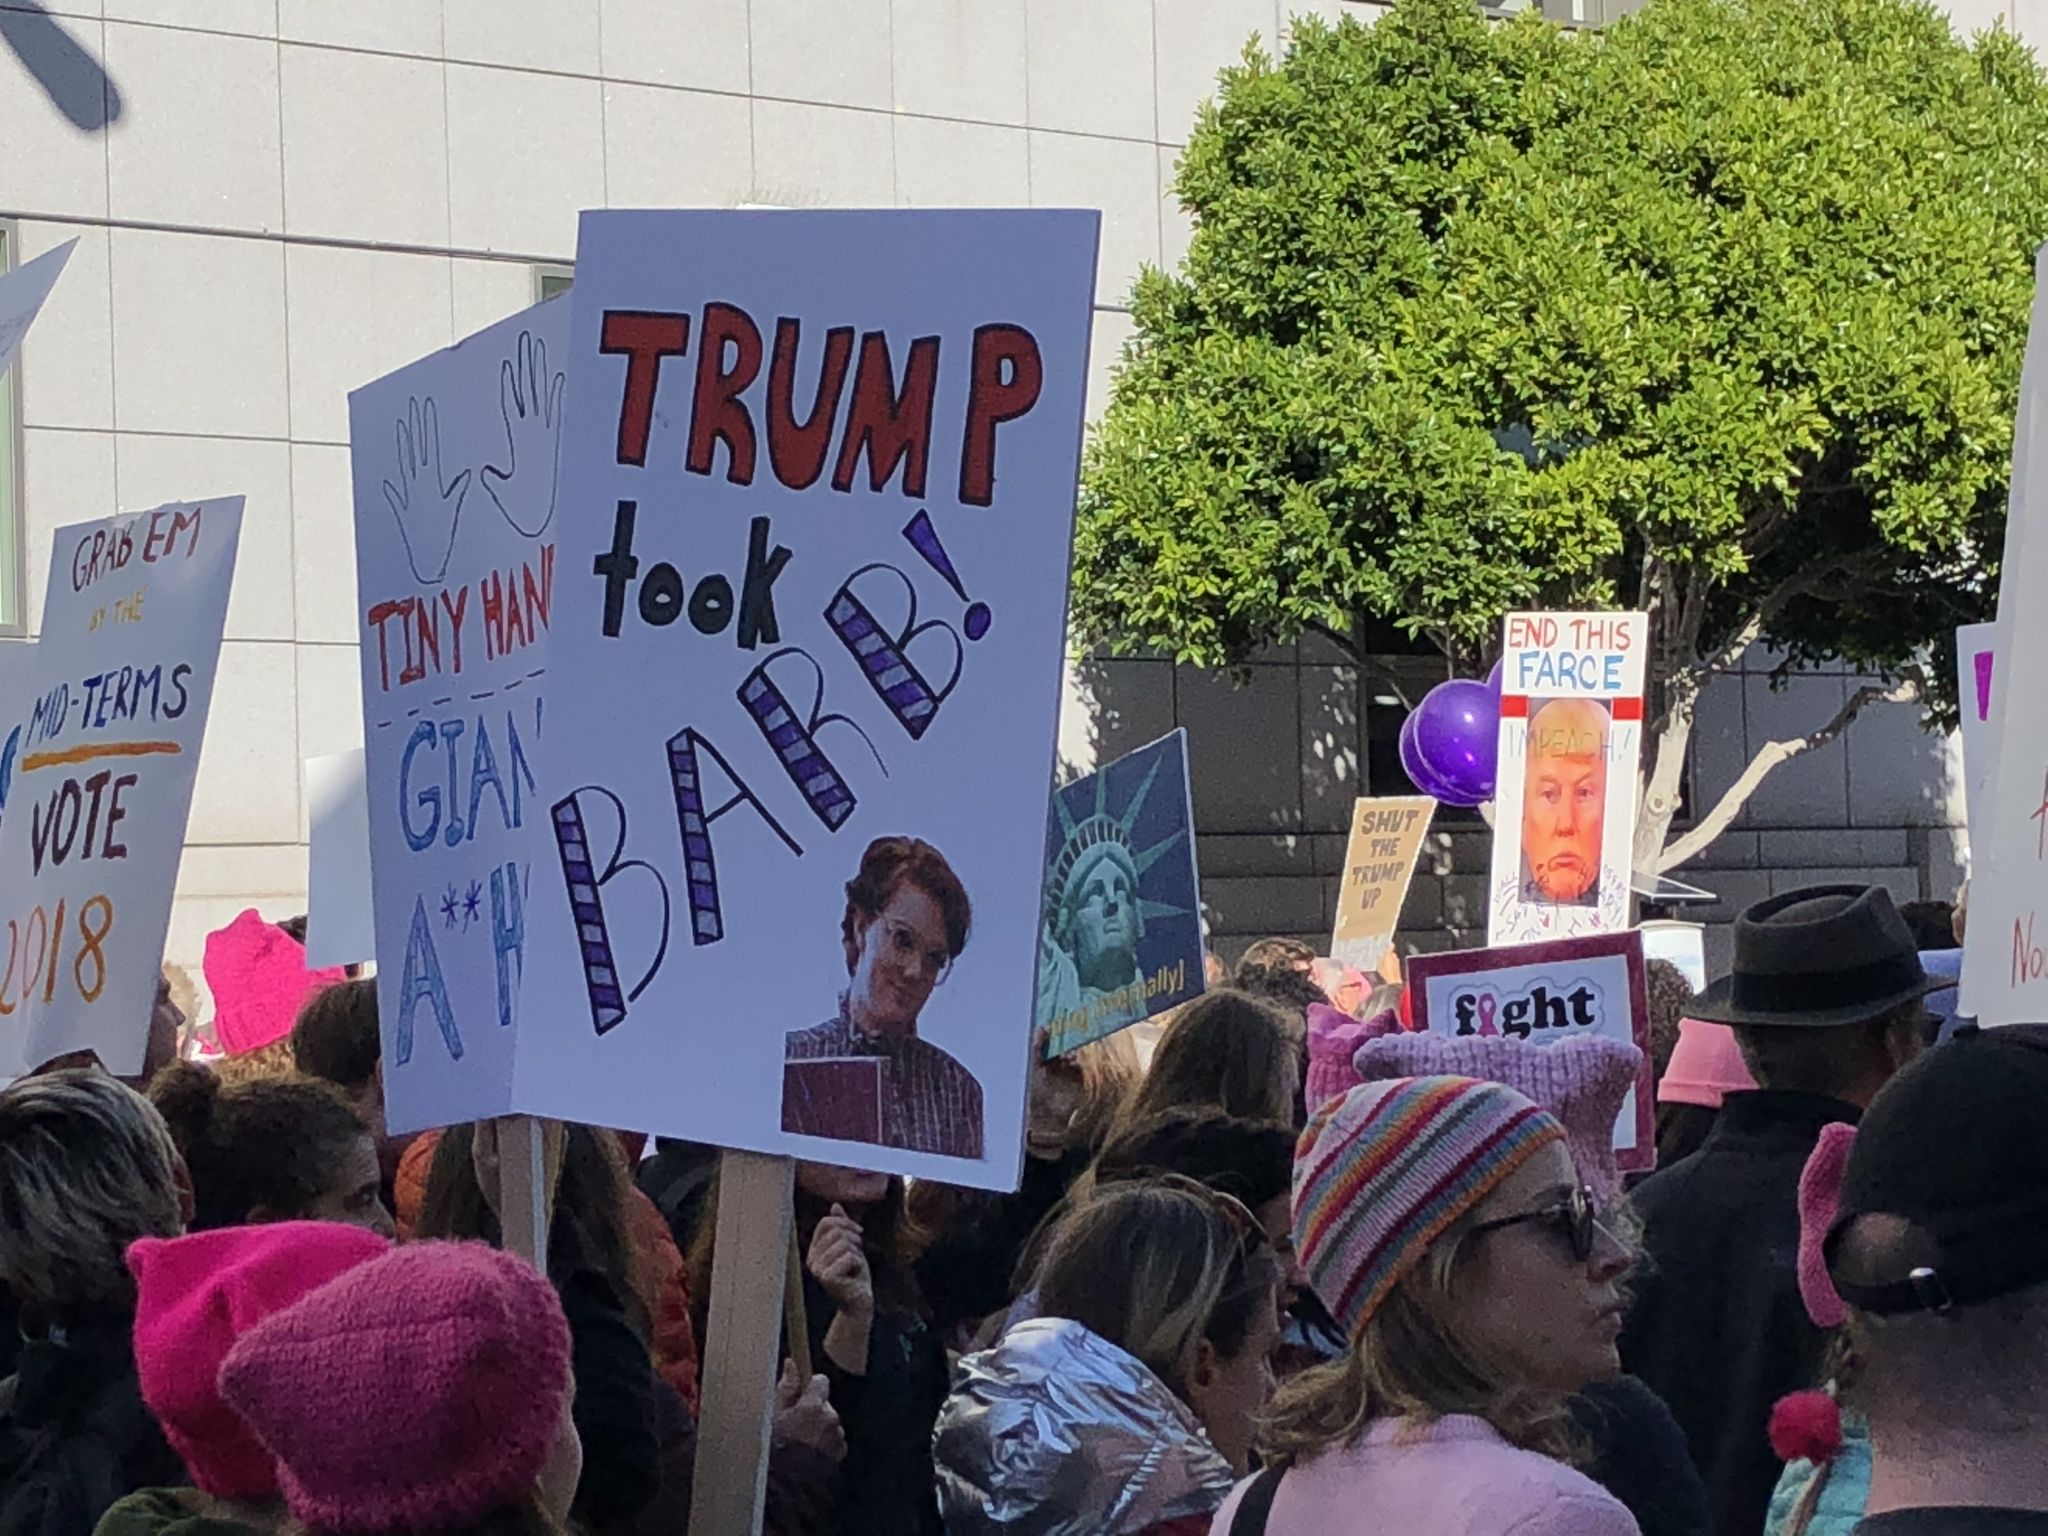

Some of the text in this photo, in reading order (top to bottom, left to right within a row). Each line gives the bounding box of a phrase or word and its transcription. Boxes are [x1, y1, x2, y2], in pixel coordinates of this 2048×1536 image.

[599, 301, 1043, 507] TRUMP
[71, 507, 202, 592] GRAB EM
[593, 499, 793, 651] took
[368, 543, 555, 692] TINY HAN
[1509, 617, 1631, 651] END THIS
[25, 663, 192, 748] MID-TERMS
[1518, 650, 1624, 690] FARCE
[550, 508, 992, 1037] BARB!
[32, 768, 138, 877] VOTE
[1361, 809, 1419, 835] SHUT
[1370, 837, 1401, 859] THE
[1352, 861, 1405, 886] TRUMP
[1361, 887, 1382, 910] UP
[0, 894, 113, 1016] 2018
